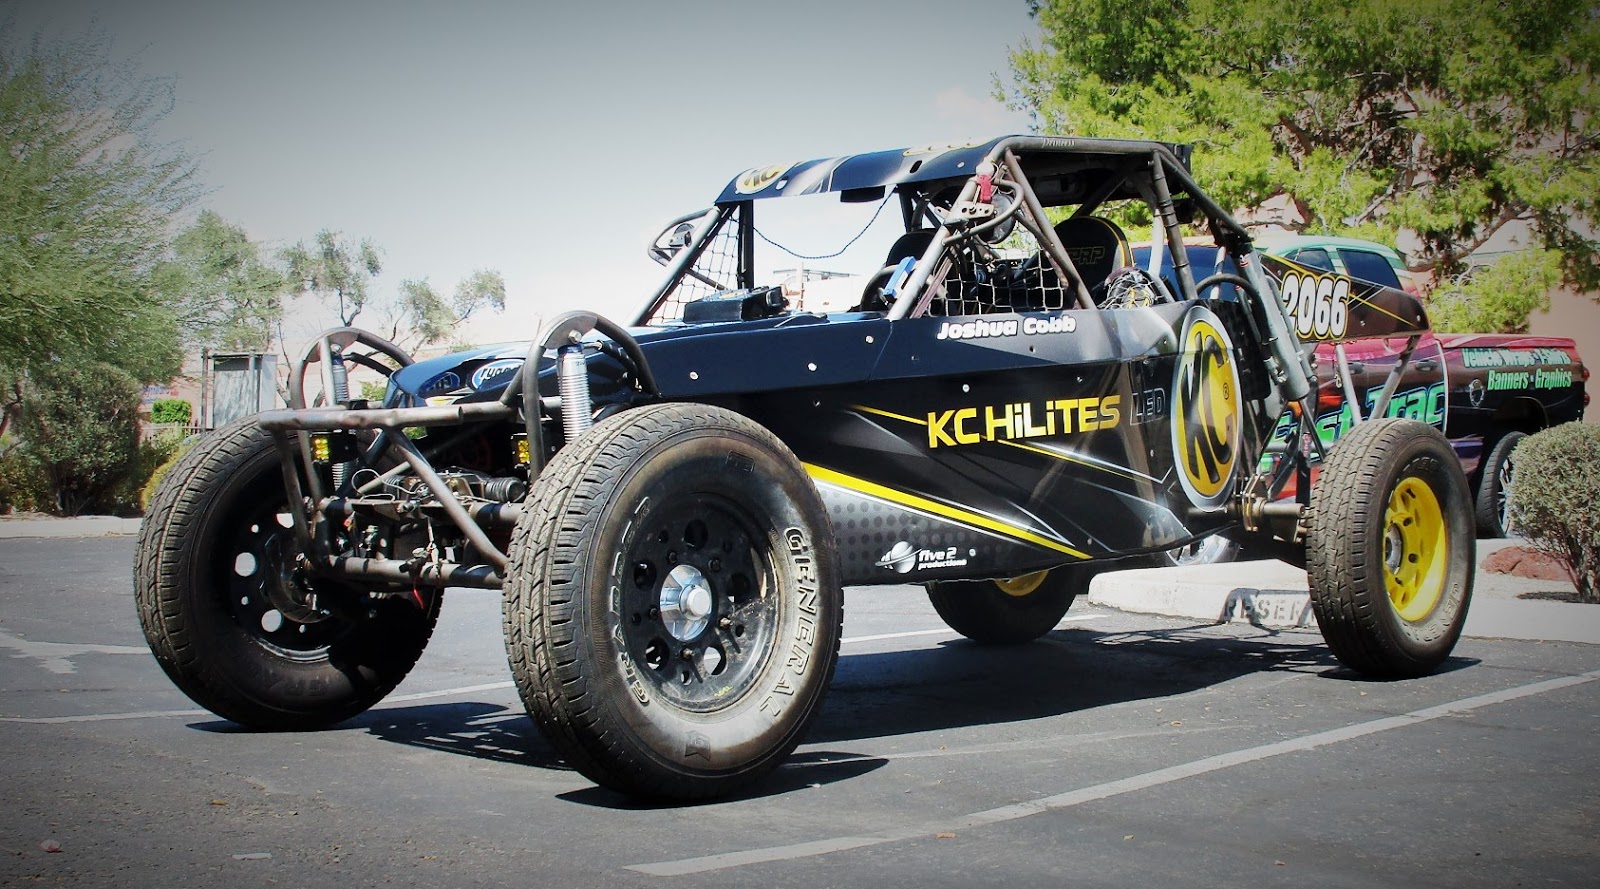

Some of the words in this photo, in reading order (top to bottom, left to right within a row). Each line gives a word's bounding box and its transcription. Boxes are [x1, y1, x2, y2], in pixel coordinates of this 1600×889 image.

[1282, 271, 1350, 339] 2066
[937, 319, 1018, 340] Joshua
[1023, 315, 1077, 335] Cobb
[1487, 369, 1529, 390] Banners
[1535, 368, 1572, 390] Graphics
[927, 407, 981, 448] KC
[1180, 331, 1233, 484] KC
[918, 549, 946, 562] five
[946, 546, 958, 560] 2
[759, 527, 817, 717] GENERAL
